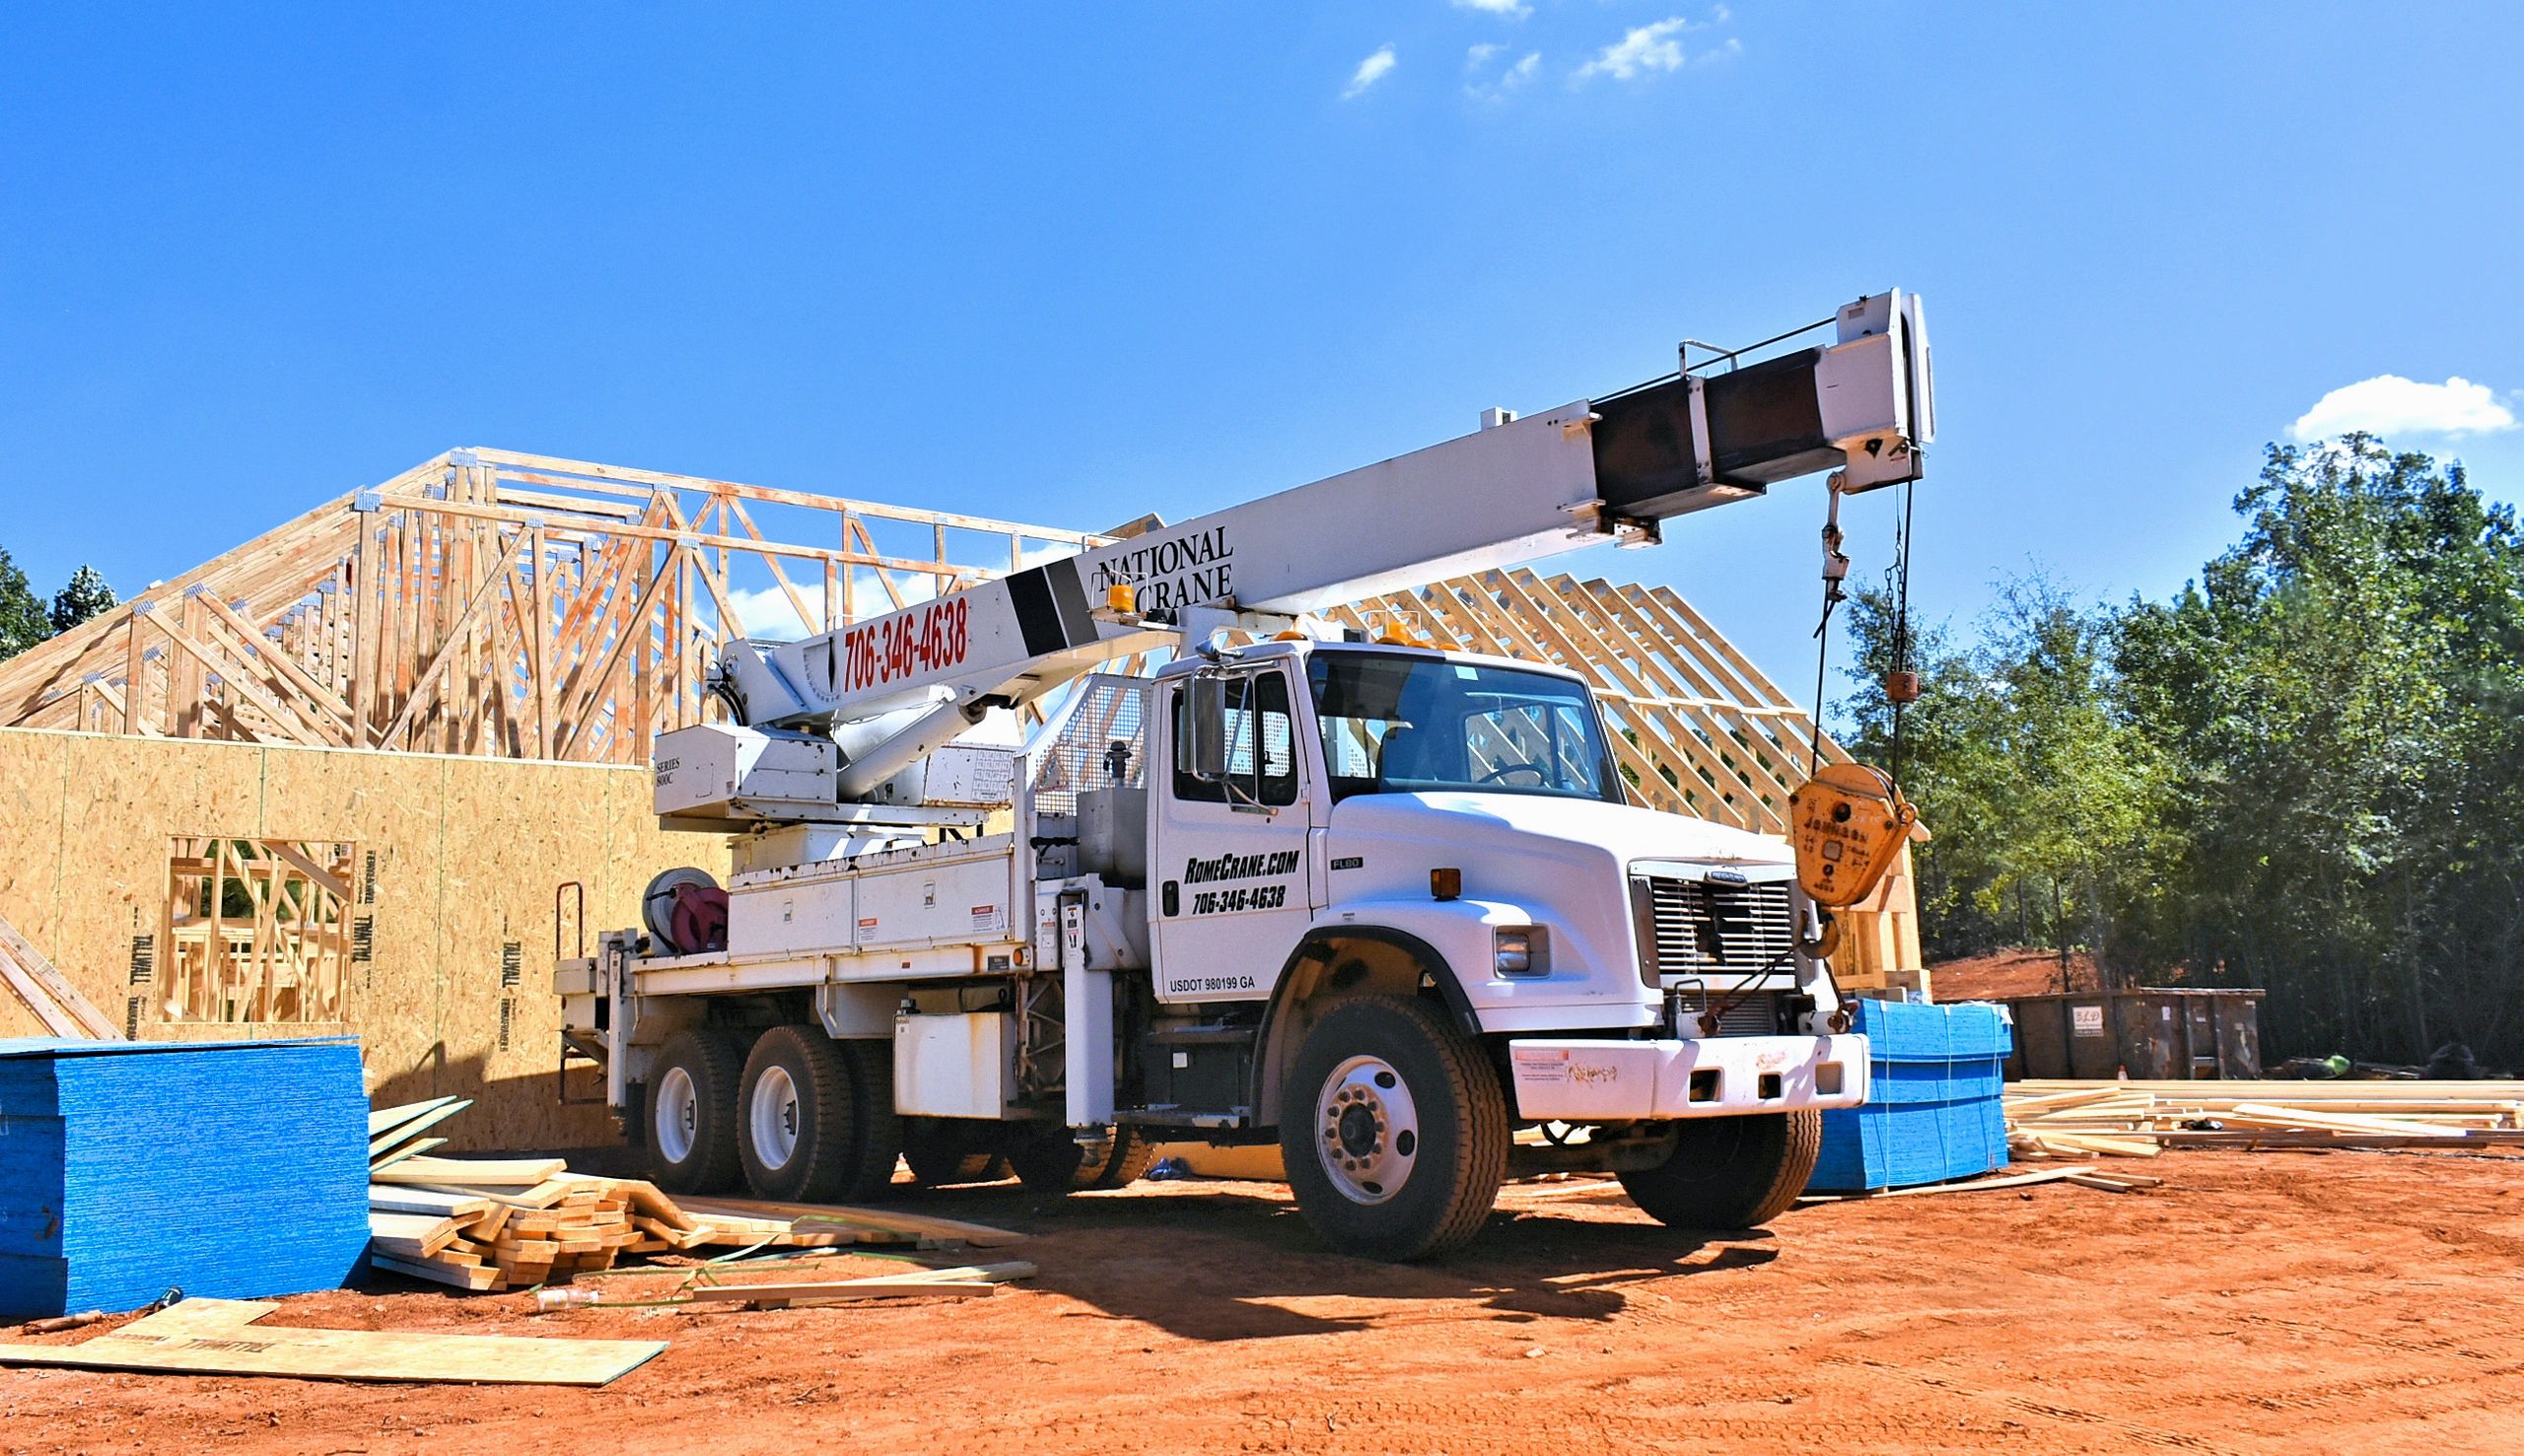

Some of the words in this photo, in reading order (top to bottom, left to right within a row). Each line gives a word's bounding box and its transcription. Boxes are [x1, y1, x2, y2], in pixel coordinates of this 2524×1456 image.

[1098, 525, 1233, 592] NATIONAL
[1135, 563, 1233, 613] CRANE
[845, 596, 967, 693] 706-346-4638
[656, 772, 674, 788] 800C
[657, 757, 679, 773] SERIES
[1192, 885, 1286, 915] 706-346-4638
[129, 935, 153, 986] TALLWALL
[352, 915, 373, 963] TALLWALL
[502, 941, 521, 988] TALLWALL
[1170, 979, 1202, 992] USDOT
[1205, 977, 1237, 991] 980199
[1239, 976, 1255, 989] GA
